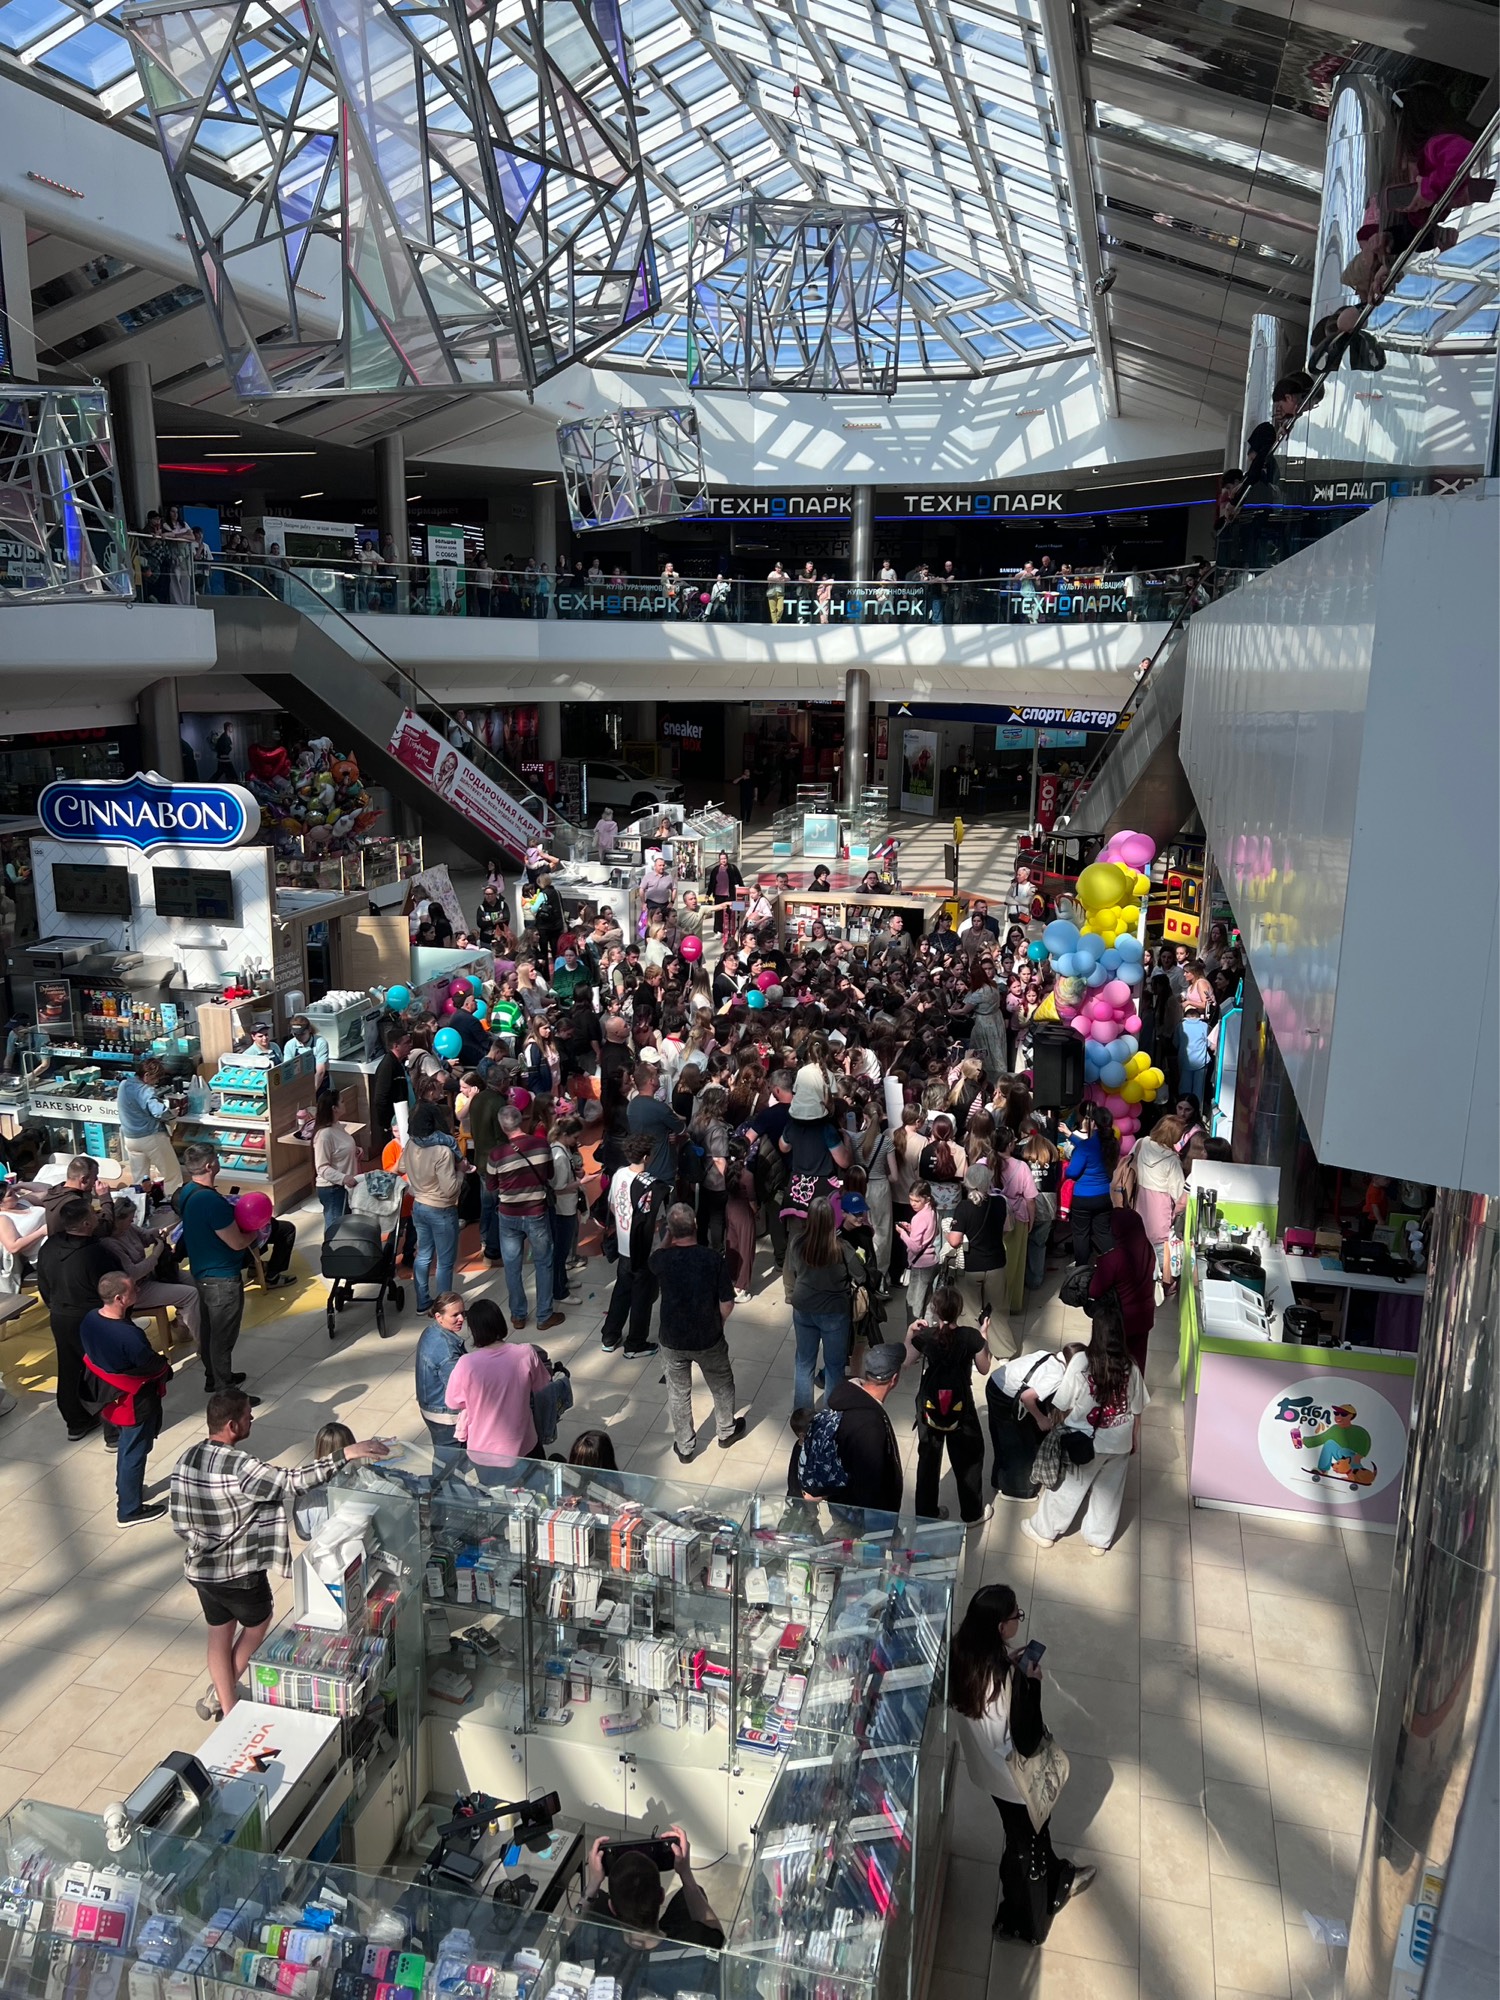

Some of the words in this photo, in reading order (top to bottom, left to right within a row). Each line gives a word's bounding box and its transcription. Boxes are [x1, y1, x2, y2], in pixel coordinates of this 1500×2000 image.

[709, 496, 852, 516] ТЕХНОПАРК
[903, 493, 1063, 514] ТЕХНОПАРК
[606, 583, 639, 591] КУЛЬТУРА
[640, 583, 680, 593] ИННОВАЙ
[883, 587, 924, 596] ННОВАЦИЙ
[543, 593, 681, 614] ТЕХНОПАРК
[783, 599, 924, 619] ТЕХНОПАРК
[1010, 594, 1124, 616] ТЕХНОПАРК
[663, 720, 704, 739] sneaker
[681, 737, 703, 753] BOX
[459, 776, 482, 798] ДЕЙСТВУЕТ
[497, 809, 515, 826] ОТДЕЛАХ
[462, 766, 517, 818] ПОДАРОЧНАЯ
[517, 814, 541, 838] КАРТА
[275, 966, 303, 984] БУЛОЧКИ
[34, 1099, 63, 1111] BAKE
[64, 1102, 93, 1113] SHOP
[99, 1106, 119, 1115] Sinc
